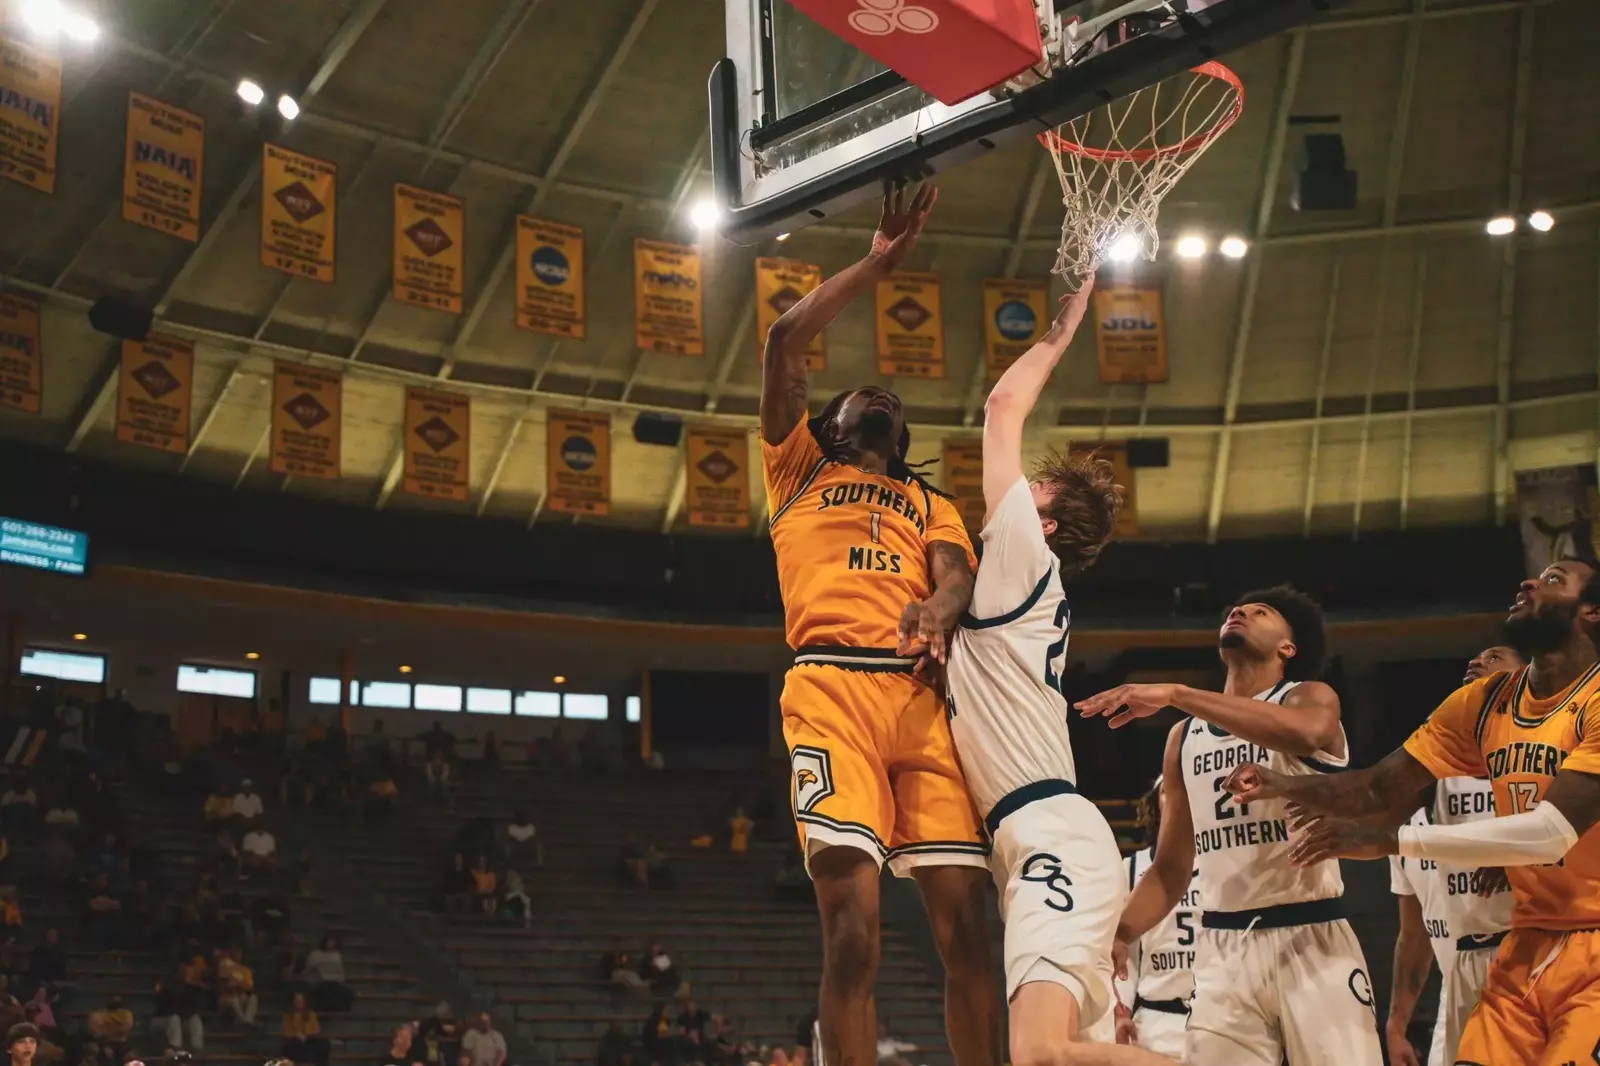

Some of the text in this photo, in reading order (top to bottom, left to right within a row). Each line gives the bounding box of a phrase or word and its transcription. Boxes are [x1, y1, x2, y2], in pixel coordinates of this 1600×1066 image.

[135, 140, 196, 182] NAIA
[818, 481, 926, 537] SOUTHERN
[869, 511, 882, 545] 1
[848, 546, 902, 574] MISS
[1193, 743, 1270, 776] GEORGIA
[1449, 791, 1496, 816] GEOR
[1508, 781, 1540, 815] 13
[1195, 819, 1289, 855] SOUTHERN
[1176, 912, 1195, 946] 5
[1150, 950, 1196, 971] SOUTH
